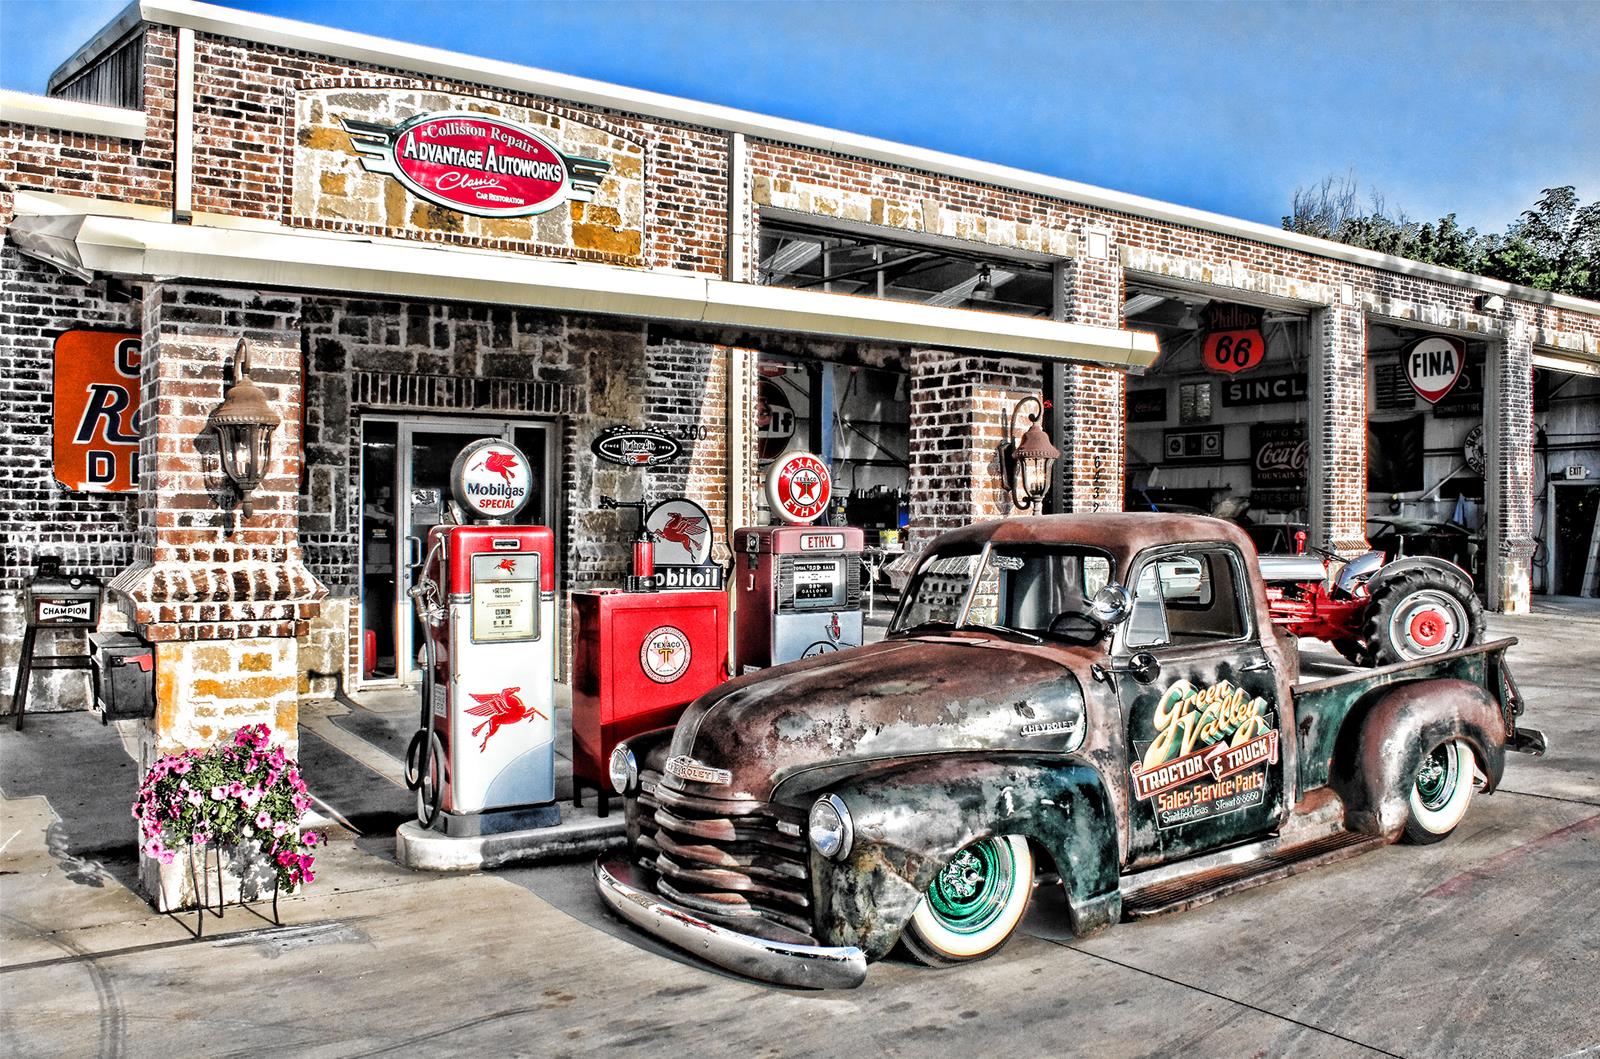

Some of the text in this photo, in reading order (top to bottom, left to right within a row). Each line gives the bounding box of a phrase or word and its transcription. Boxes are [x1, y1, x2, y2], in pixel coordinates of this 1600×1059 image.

[427, 123, 533, 154] Collision Repair
[402, 131, 562, 183] ADVANTAGE AUTOWORKS
[435, 171, 503, 190] Classic
[476, 191, 488, 201] CAR
[1211, 304, 1257, 330] Phillips
[1215, 335, 1253, 367] 66
[1412, 350, 1455, 378] FINA
[1230, 379, 1307, 400] SINCL
[72, 382, 140, 446] R
[781, 458, 828, 482] TEXACO
[1569, 466, 1583, 476] EXIT
[467, 482, 525, 499] Mobilgas
[479, 499, 515, 509] SPECIAL
[783, 498, 826, 516] ETHYL
[807, 536, 836, 549] ETHYL
[655, 568, 718, 588] obiloil
[42, 607, 87, 615] CHAMPION
[653, 641, 681, 649] TEXACO
[1022, 721, 1074, 733] CHEVROLET
[1175, 687, 1266, 758] Valley
[1139, 756, 1204, 793] TRACTOR
[1228, 739, 1268, 770] TRUCK
[1158, 772, 1264, 812] Sales Service Parts
